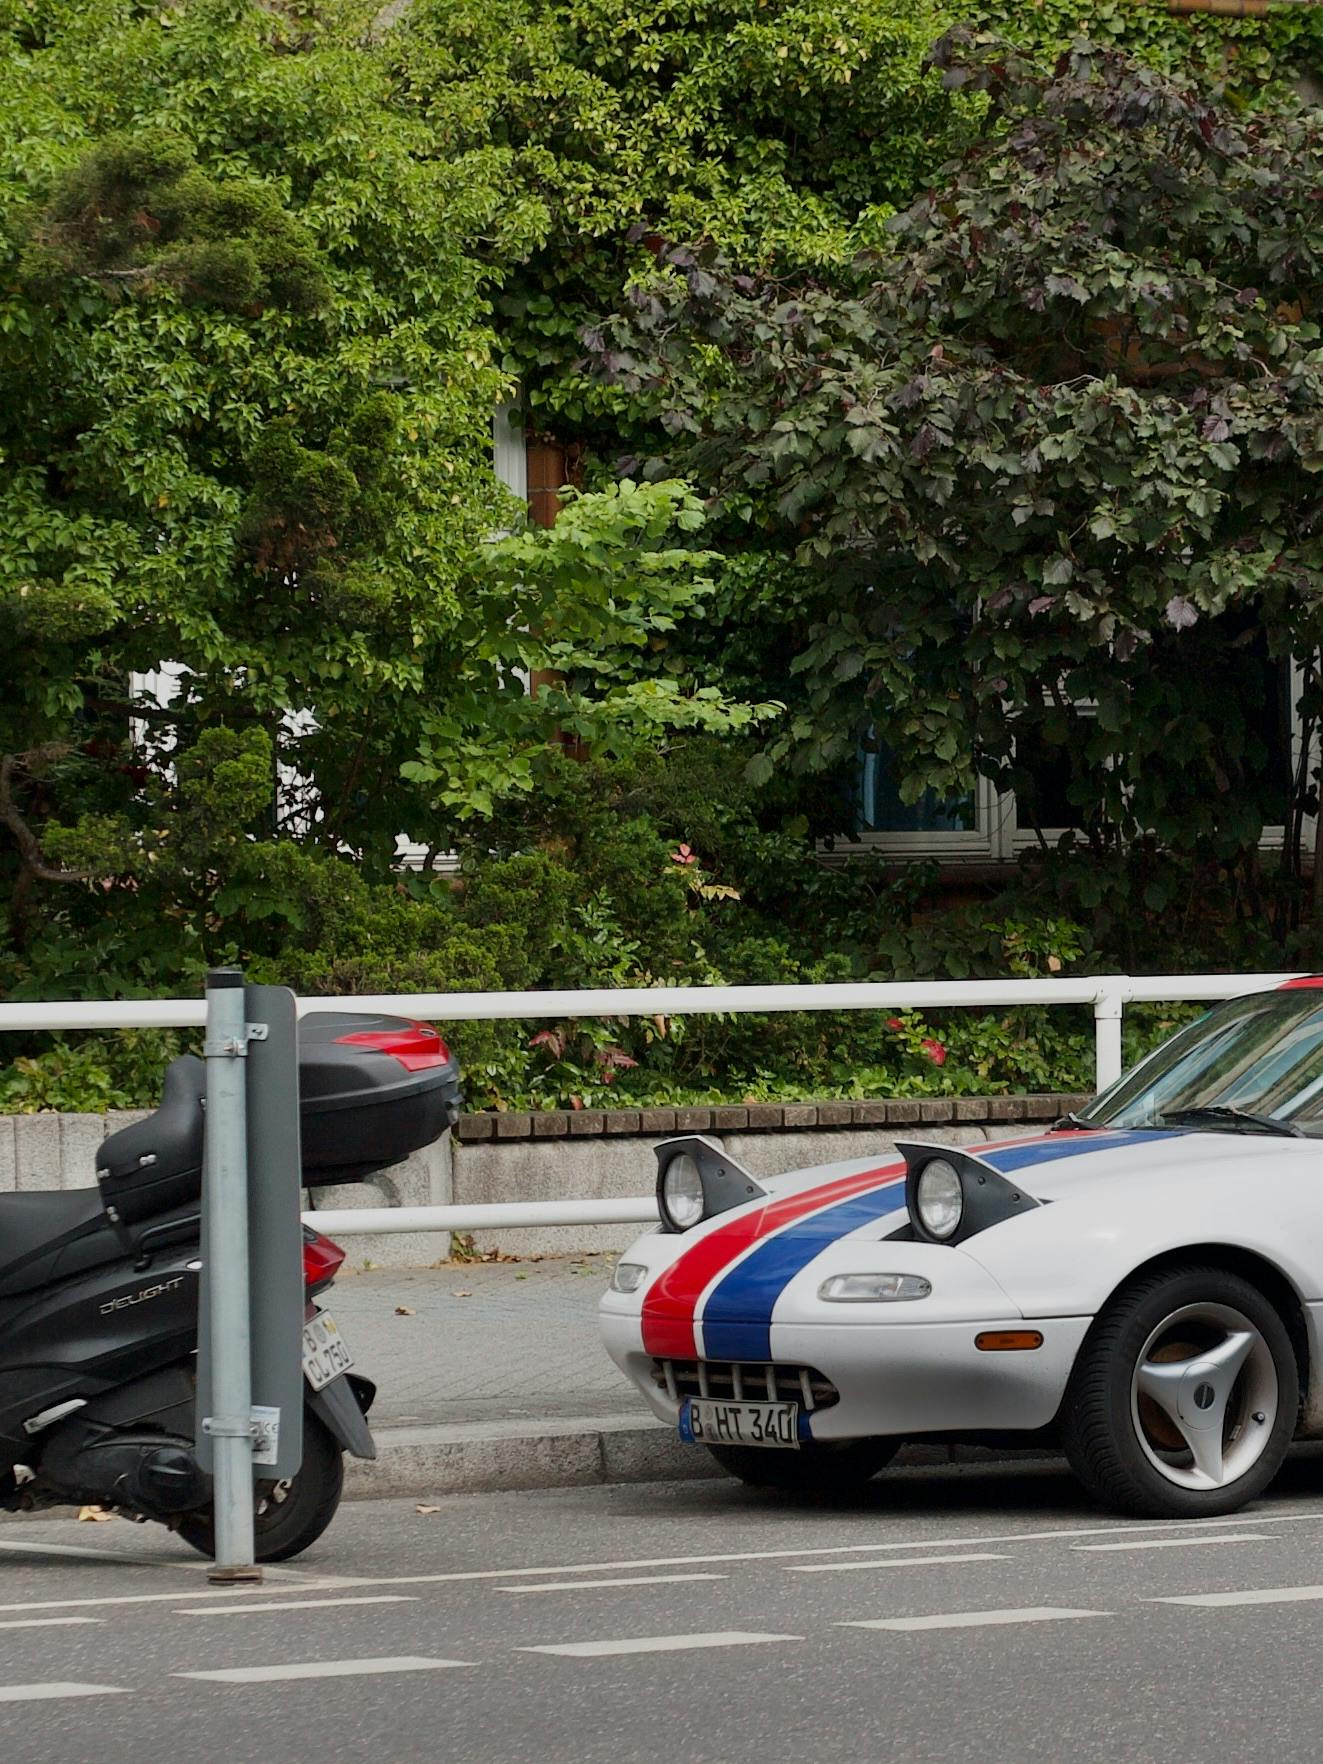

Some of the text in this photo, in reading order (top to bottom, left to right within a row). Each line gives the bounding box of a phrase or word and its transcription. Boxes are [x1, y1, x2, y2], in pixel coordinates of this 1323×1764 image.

[304, 1329, 317, 1352] B
[690, 1405, 704, 1438] B
[715, 1406, 743, 1441] HT
[748, 1408, 793, 1443] 340
